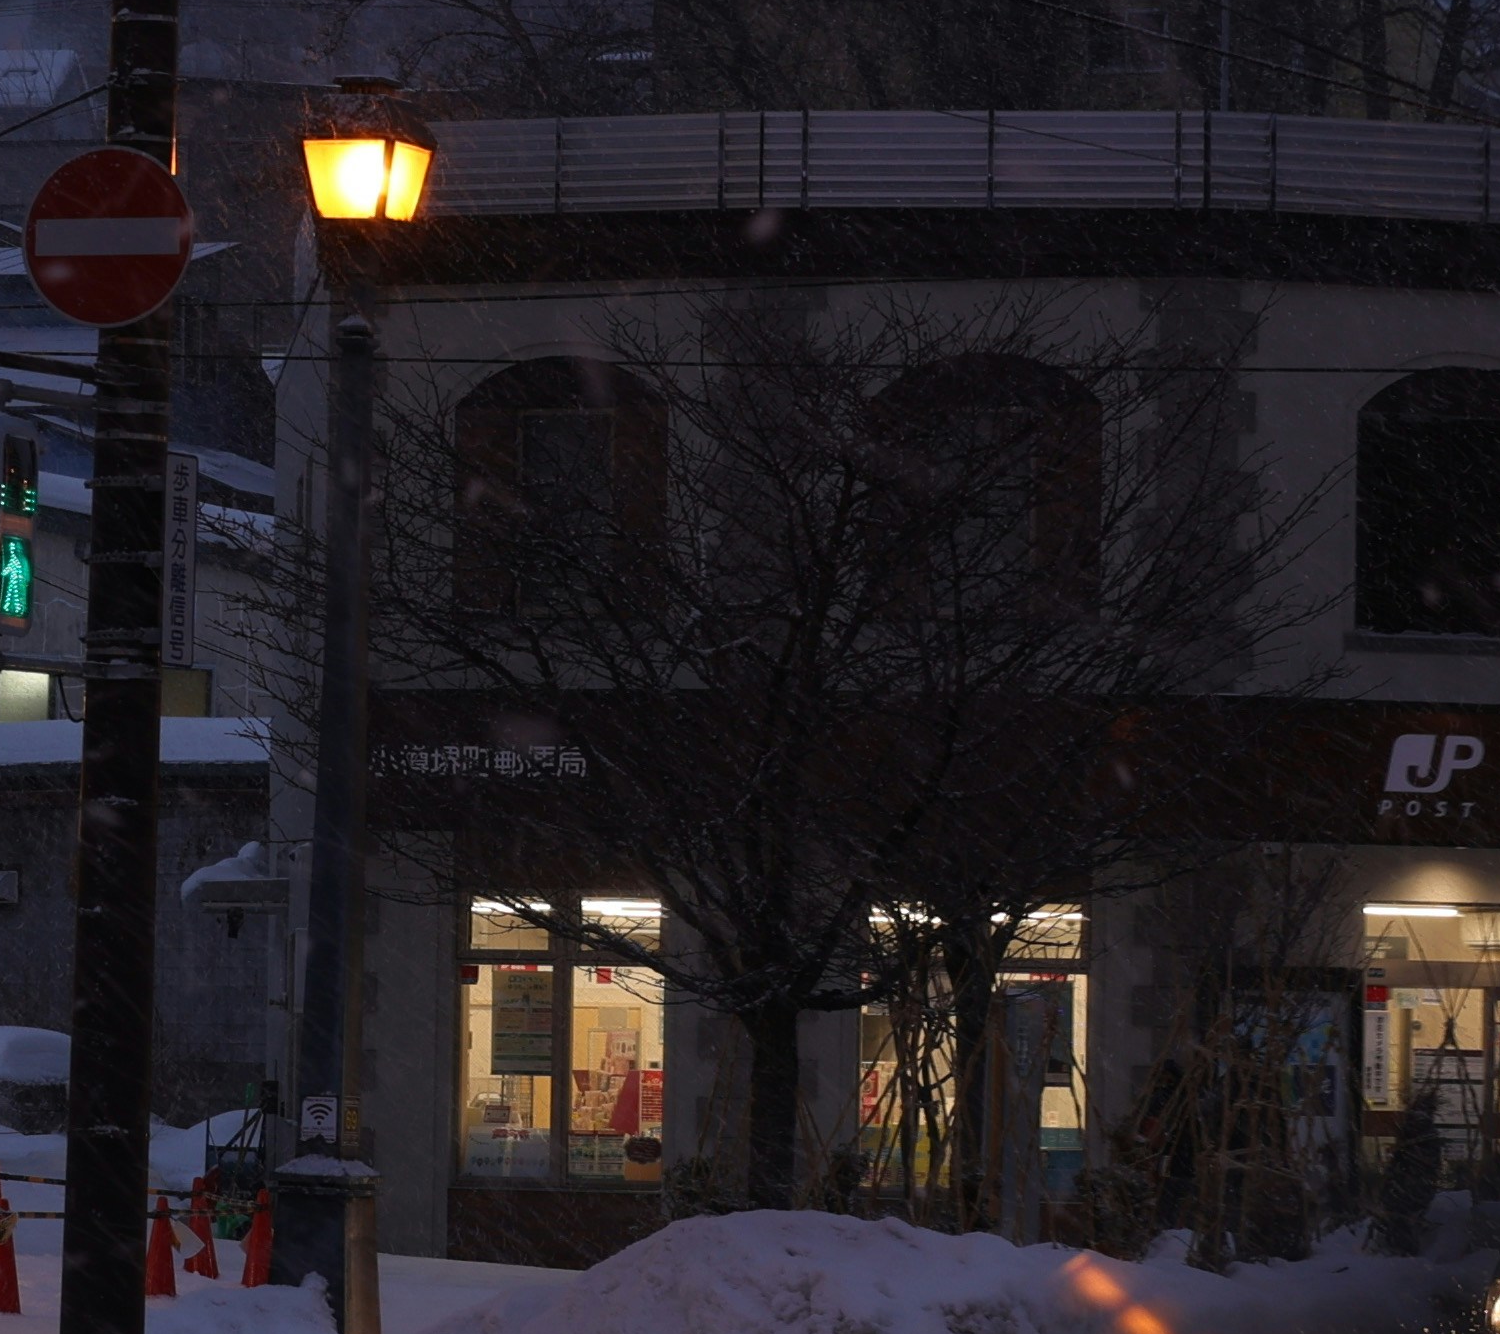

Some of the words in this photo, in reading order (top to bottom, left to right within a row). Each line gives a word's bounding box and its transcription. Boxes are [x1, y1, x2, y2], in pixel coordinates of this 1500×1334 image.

[168, 462, 190, 661] 歩車分離信号
[1377, 799, 1477, 818] POST
